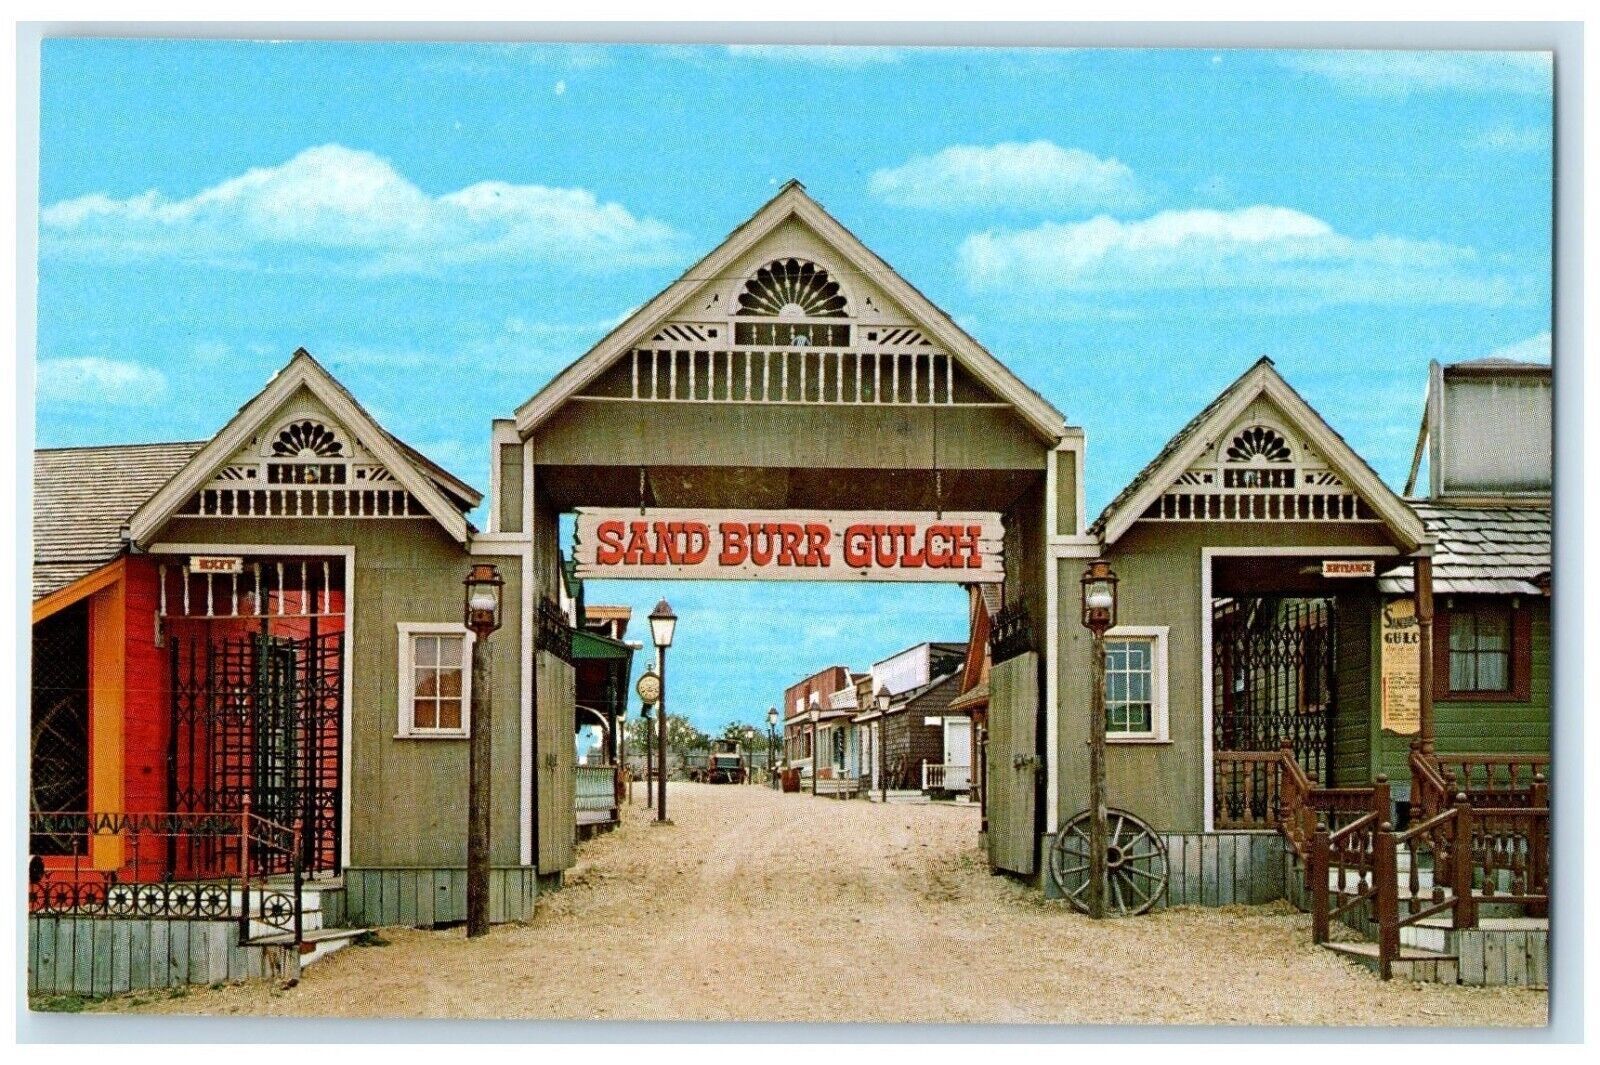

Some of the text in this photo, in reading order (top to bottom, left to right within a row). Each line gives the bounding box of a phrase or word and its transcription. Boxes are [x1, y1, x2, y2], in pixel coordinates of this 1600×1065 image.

[597, 520, 982, 568] SAND BURR GULCH
